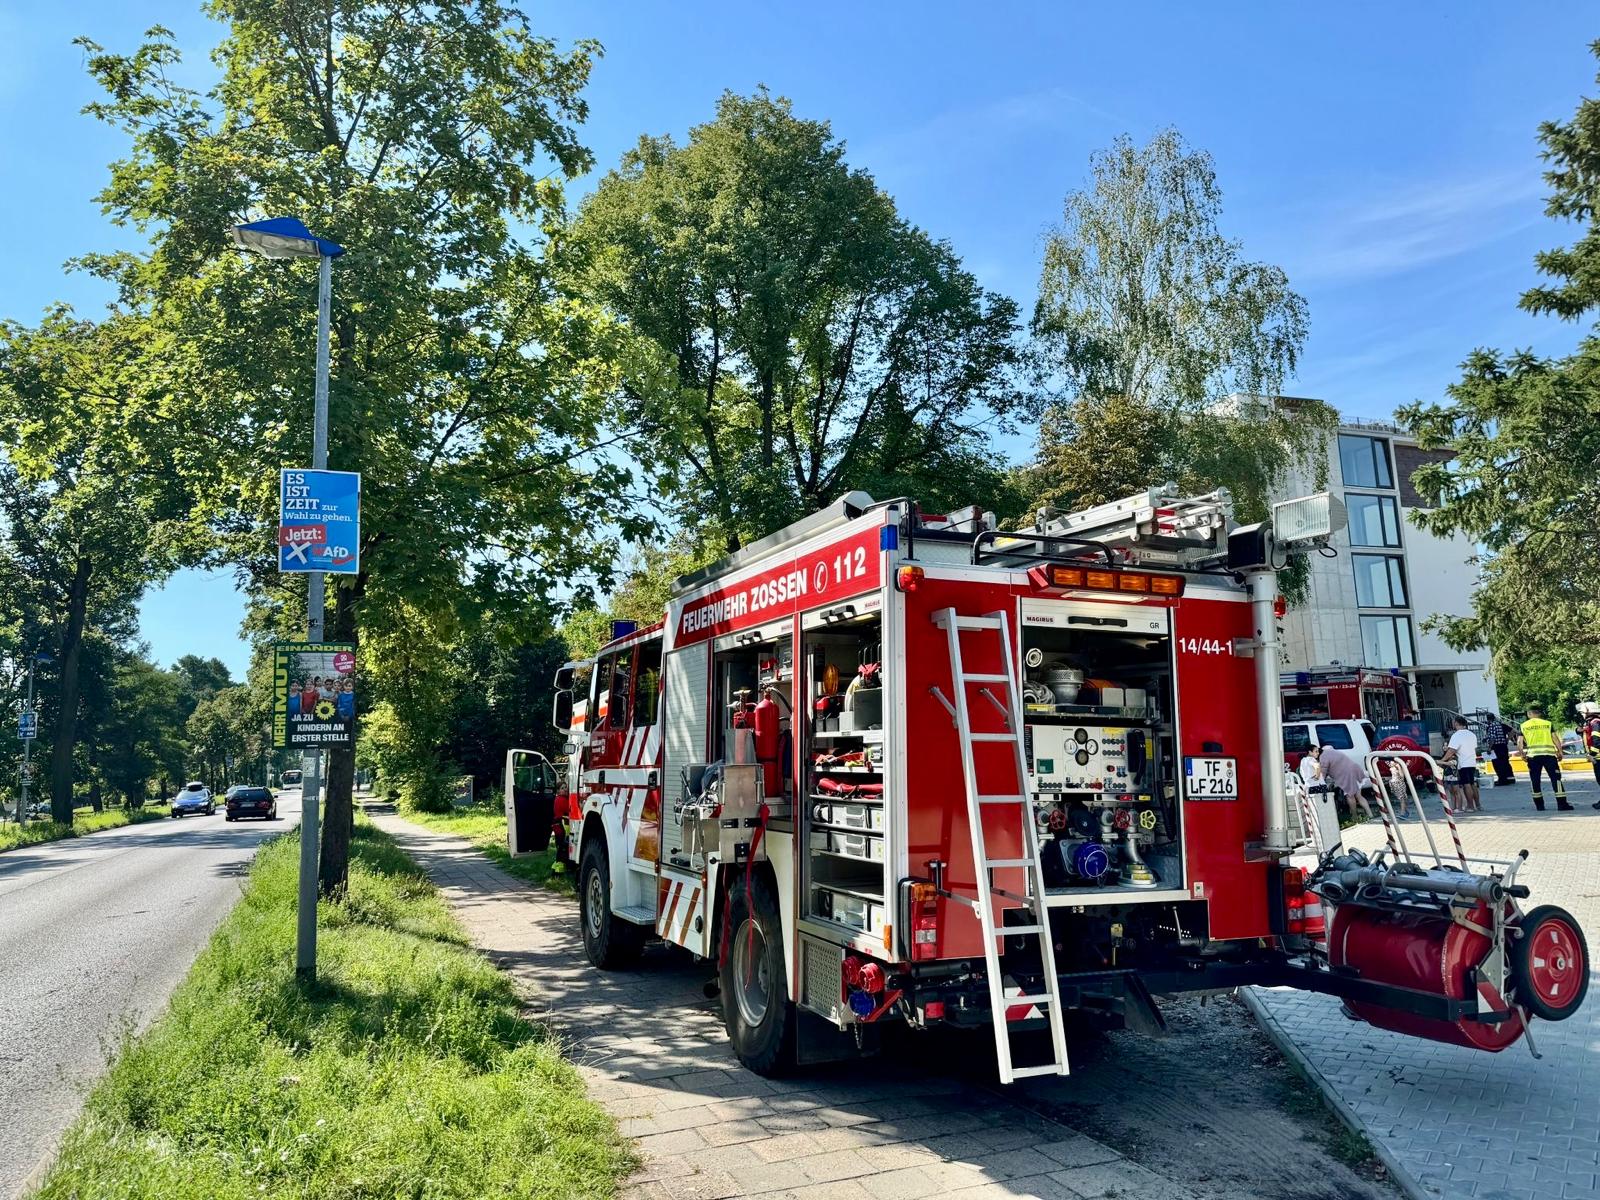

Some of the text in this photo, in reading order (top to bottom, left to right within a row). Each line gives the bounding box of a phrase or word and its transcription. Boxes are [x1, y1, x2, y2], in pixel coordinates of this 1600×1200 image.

[286, 473, 305, 485] ES
[285, 485, 310, 497] IST
[285, 498, 320, 510] ZEIT
[284, 511, 309, 520] Wahl
[321, 512, 353, 522] gehen.
[284, 528, 322, 541] Jetzt:
[323, 546, 349, 558] AfD
[682, 546, 867, 635] FEUERWEHR ZOSSEN 112
[1178, 637, 1234, 656] 14/44-1
[274, 652, 288, 747] MEHR MUT
[291, 713, 314, 722] JA ZU
[297, 723, 345, 732] KINDERN AN
[291, 733, 350, 743] ERSTER STELLE
[1204, 760, 1221, 777] TF
[1190, 778, 1233, 794] LF 216
